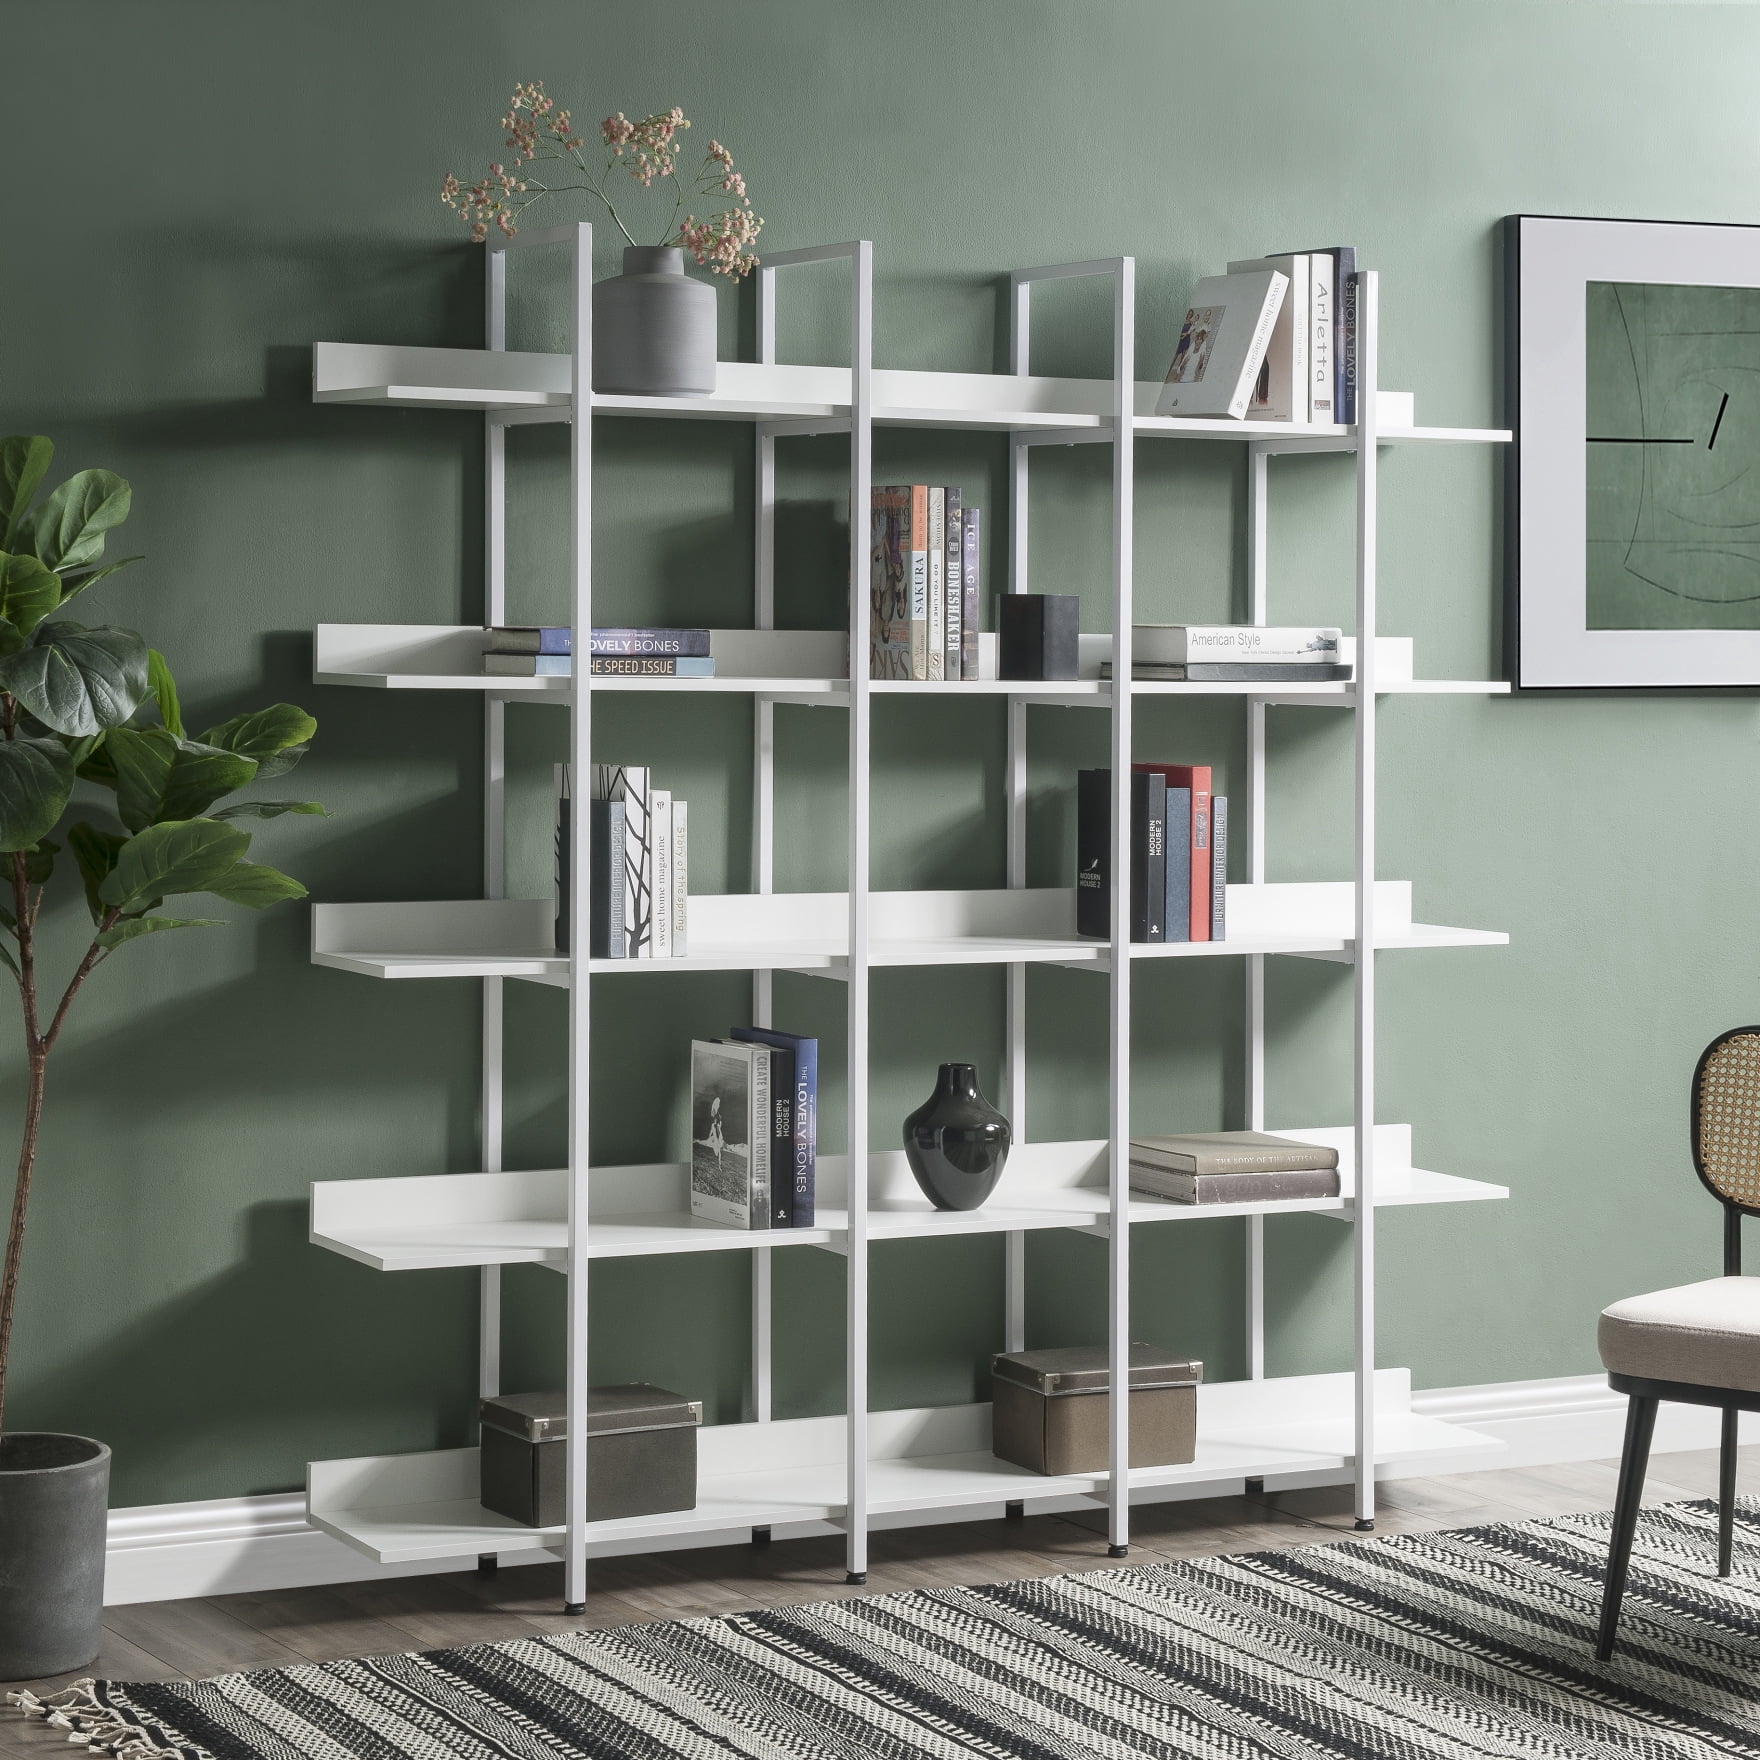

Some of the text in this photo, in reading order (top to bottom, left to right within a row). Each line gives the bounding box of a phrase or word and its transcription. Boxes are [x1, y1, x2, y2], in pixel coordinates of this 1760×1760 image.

[1245, 282, 1281, 380] sweet home magazine
[1316, 282, 1328, 382] Arletta
[1345, 281, 1356, 329] BONES
[1346, 331, 1356, 386] LOVELY
[915, 557, 924, 614] SAKURA
[934, 564, 938, 576] DO
[967, 524, 975, 595] ICE AGE
[948, 561, 960, 651] BONESHAKER
[591, 640, 630, 651] OVELY
[635, 641, 679, 652] BONES
[591, 660, 673, 674] HE SPEED ISSUE
[1191, 632, 1260, 648] American Style
[657, 836, 667, 884] magazine
[675, 827, 686, 931] Story of the spring
[657, 885, 665, 915] home
[756, 1056, 767, 1184] CREATE WONDERFUL HOMELIFE
[797, 1083, 807, 1138] LOVELY
[797, 1143, 807, 1193] BONES
